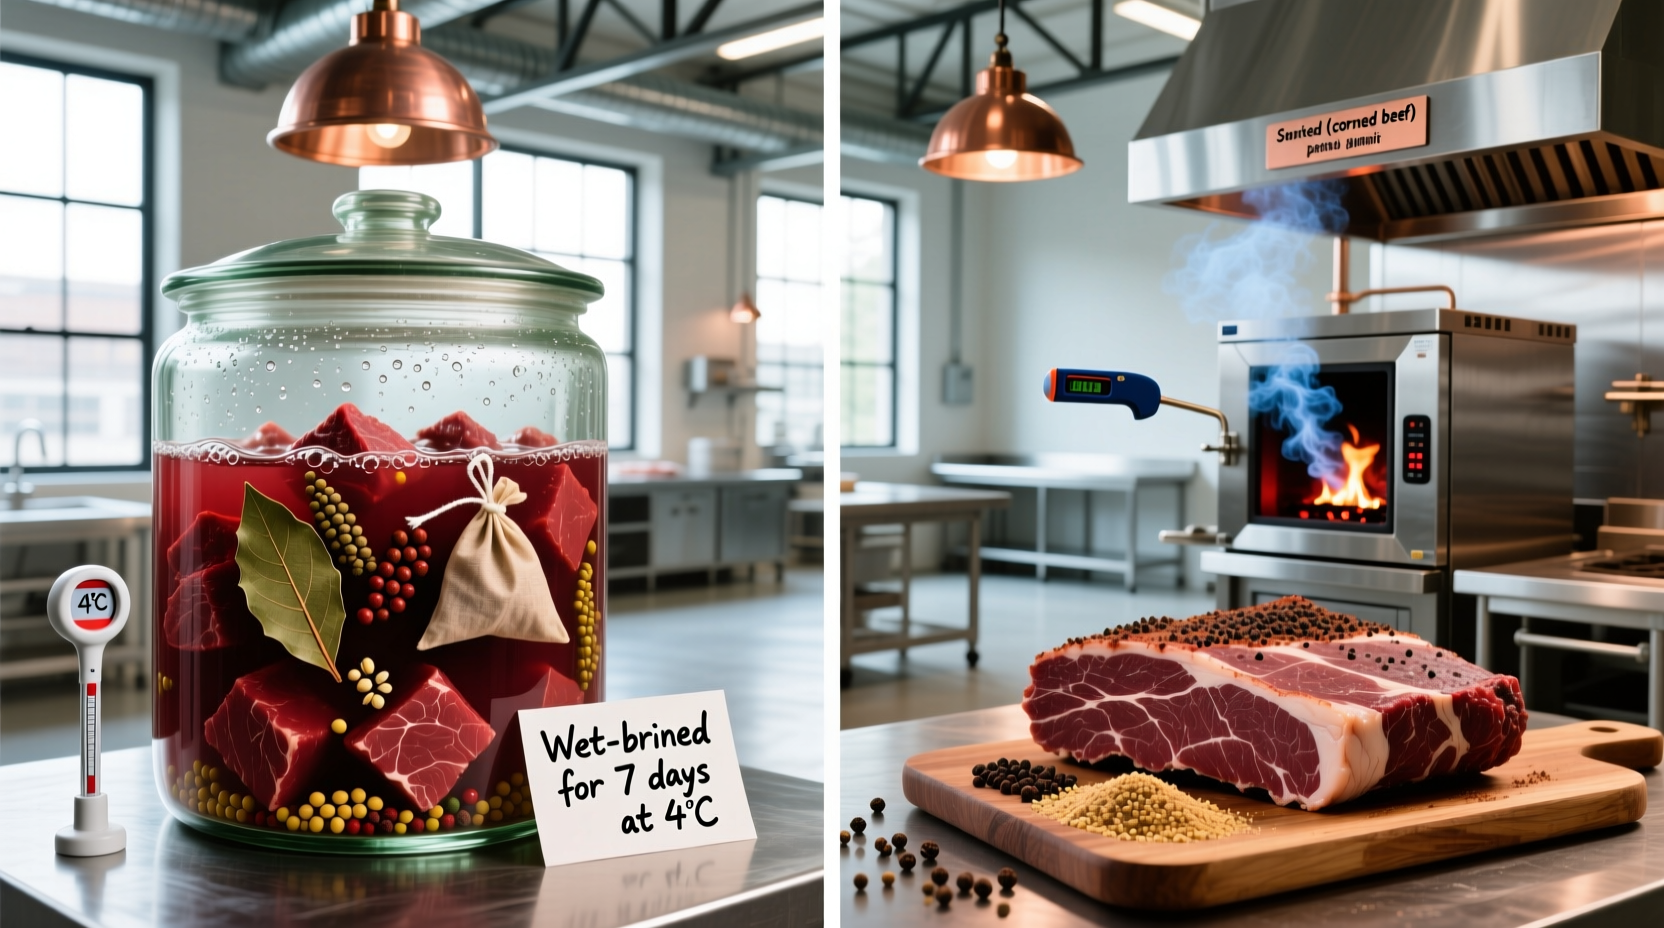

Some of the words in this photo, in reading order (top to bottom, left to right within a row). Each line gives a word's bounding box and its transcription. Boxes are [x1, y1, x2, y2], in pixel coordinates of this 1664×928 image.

[1326, 110, 1378, 137] (corned
[1381, 102, 1416, 125] beef)
[540, 709, 711, 763] Wet-brined
[557, 768, 605, 808] for
[614, 763, 636, 796] 7
[648, 757, 711, 798] days
[621, 803, 654, 835] at
[664, 795, 719, 831] 4°C
